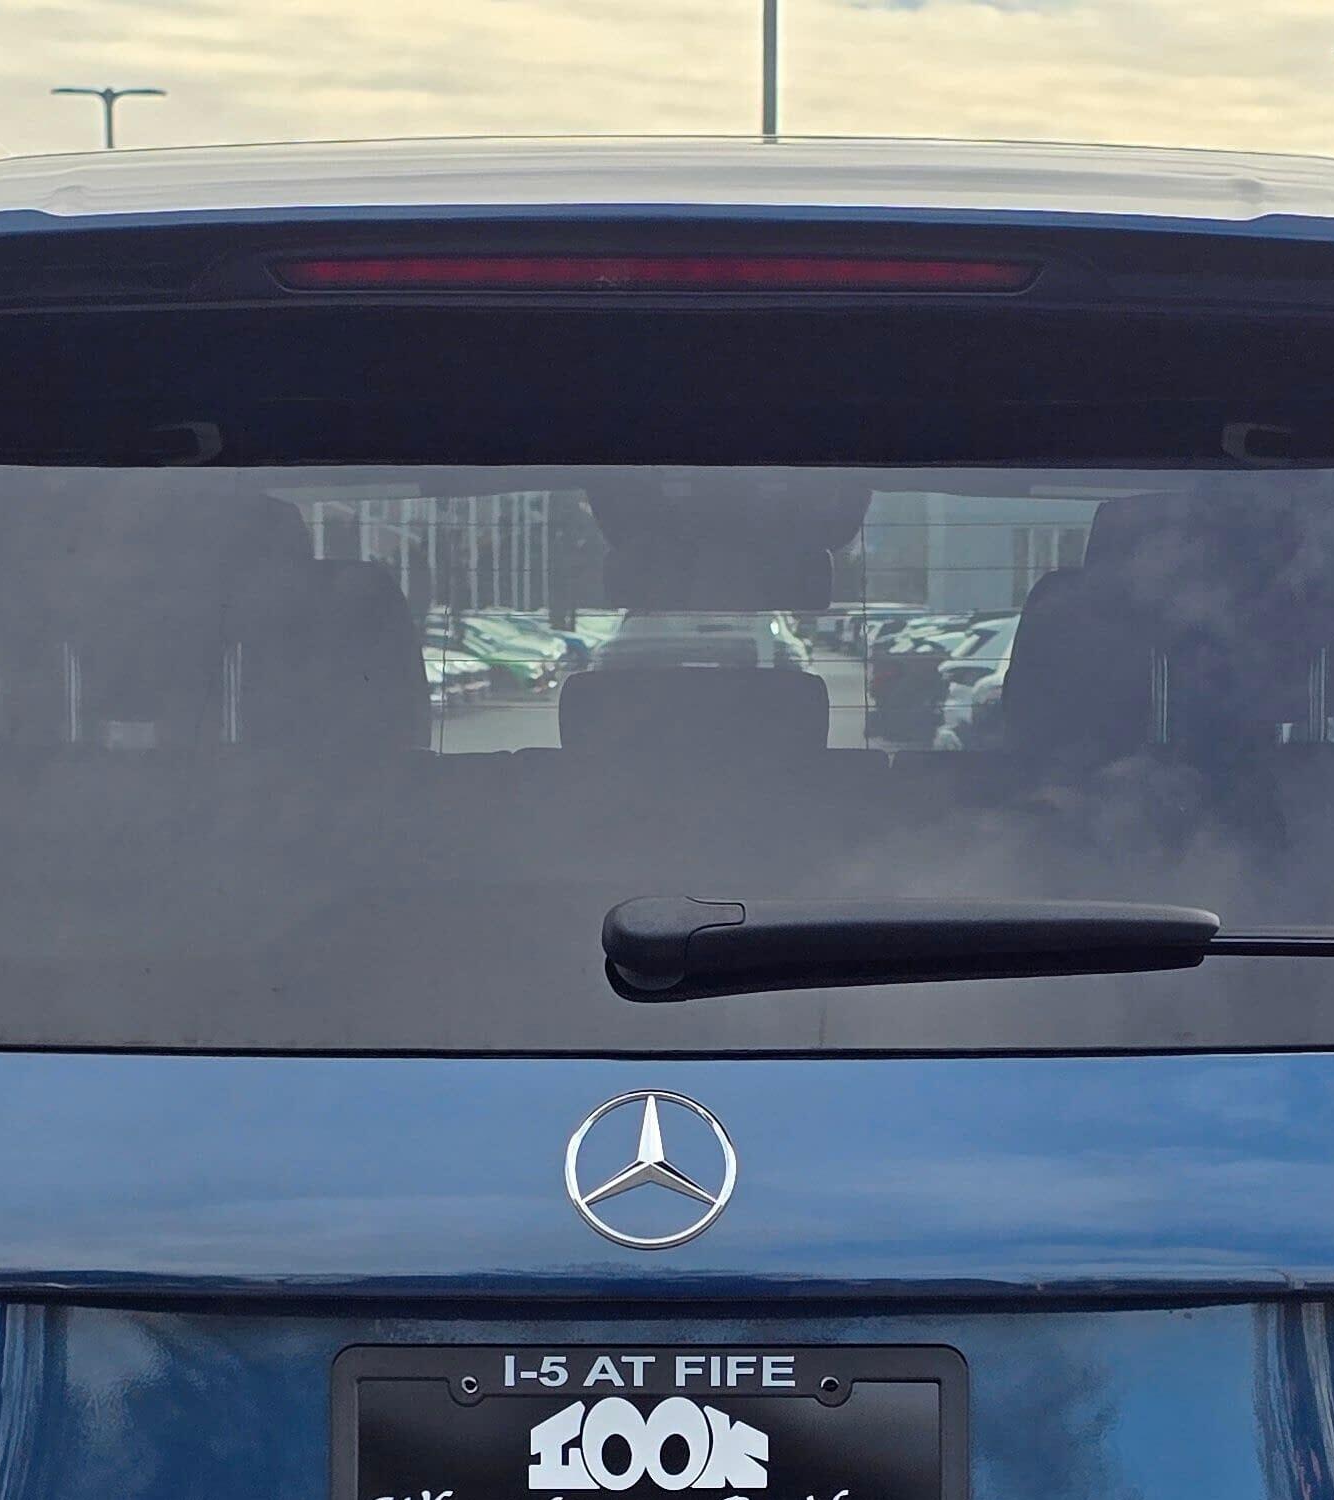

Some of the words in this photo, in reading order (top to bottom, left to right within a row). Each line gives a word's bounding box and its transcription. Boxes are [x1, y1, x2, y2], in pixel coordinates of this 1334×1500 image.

[503, 1355, 569, 1388] I-5
[582, 1355, 656, 1388] AT
[675, 1355, 796, 1388] FIFE
[528, 1396, 769, 1491] LOOK
